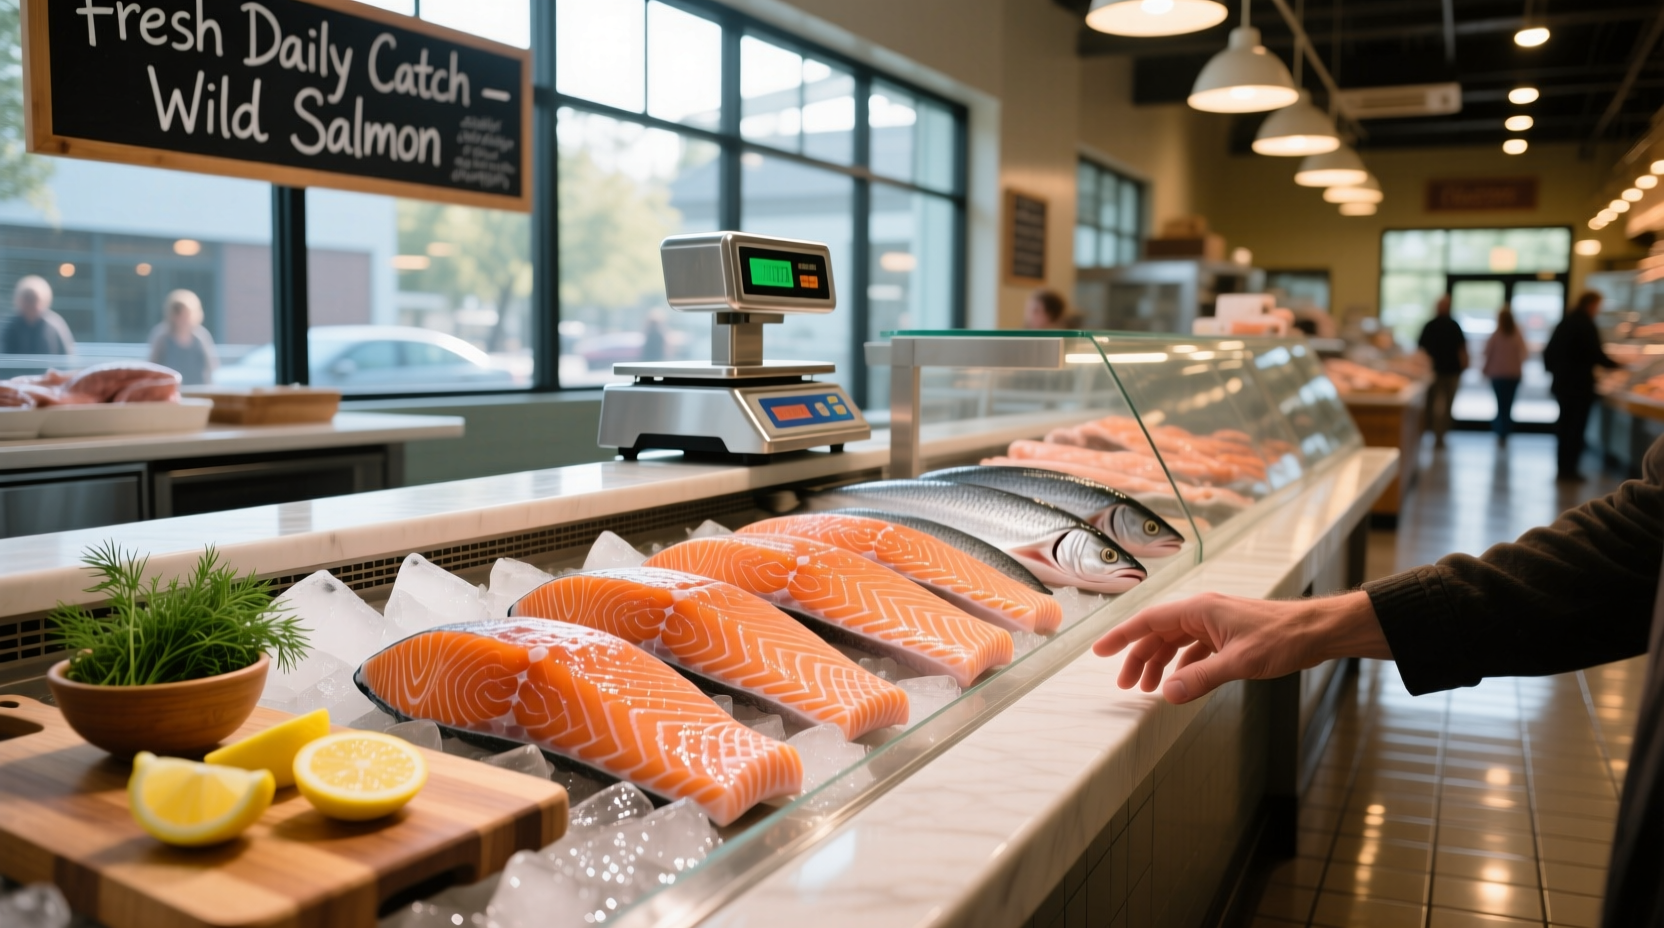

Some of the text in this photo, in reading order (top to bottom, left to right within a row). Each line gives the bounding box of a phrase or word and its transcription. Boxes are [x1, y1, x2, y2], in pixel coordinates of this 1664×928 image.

[241, 1, 354, 104] Daily
[367, 32, 471, 107] Catch
[147, 64, 441, 167] Wild Salmon
